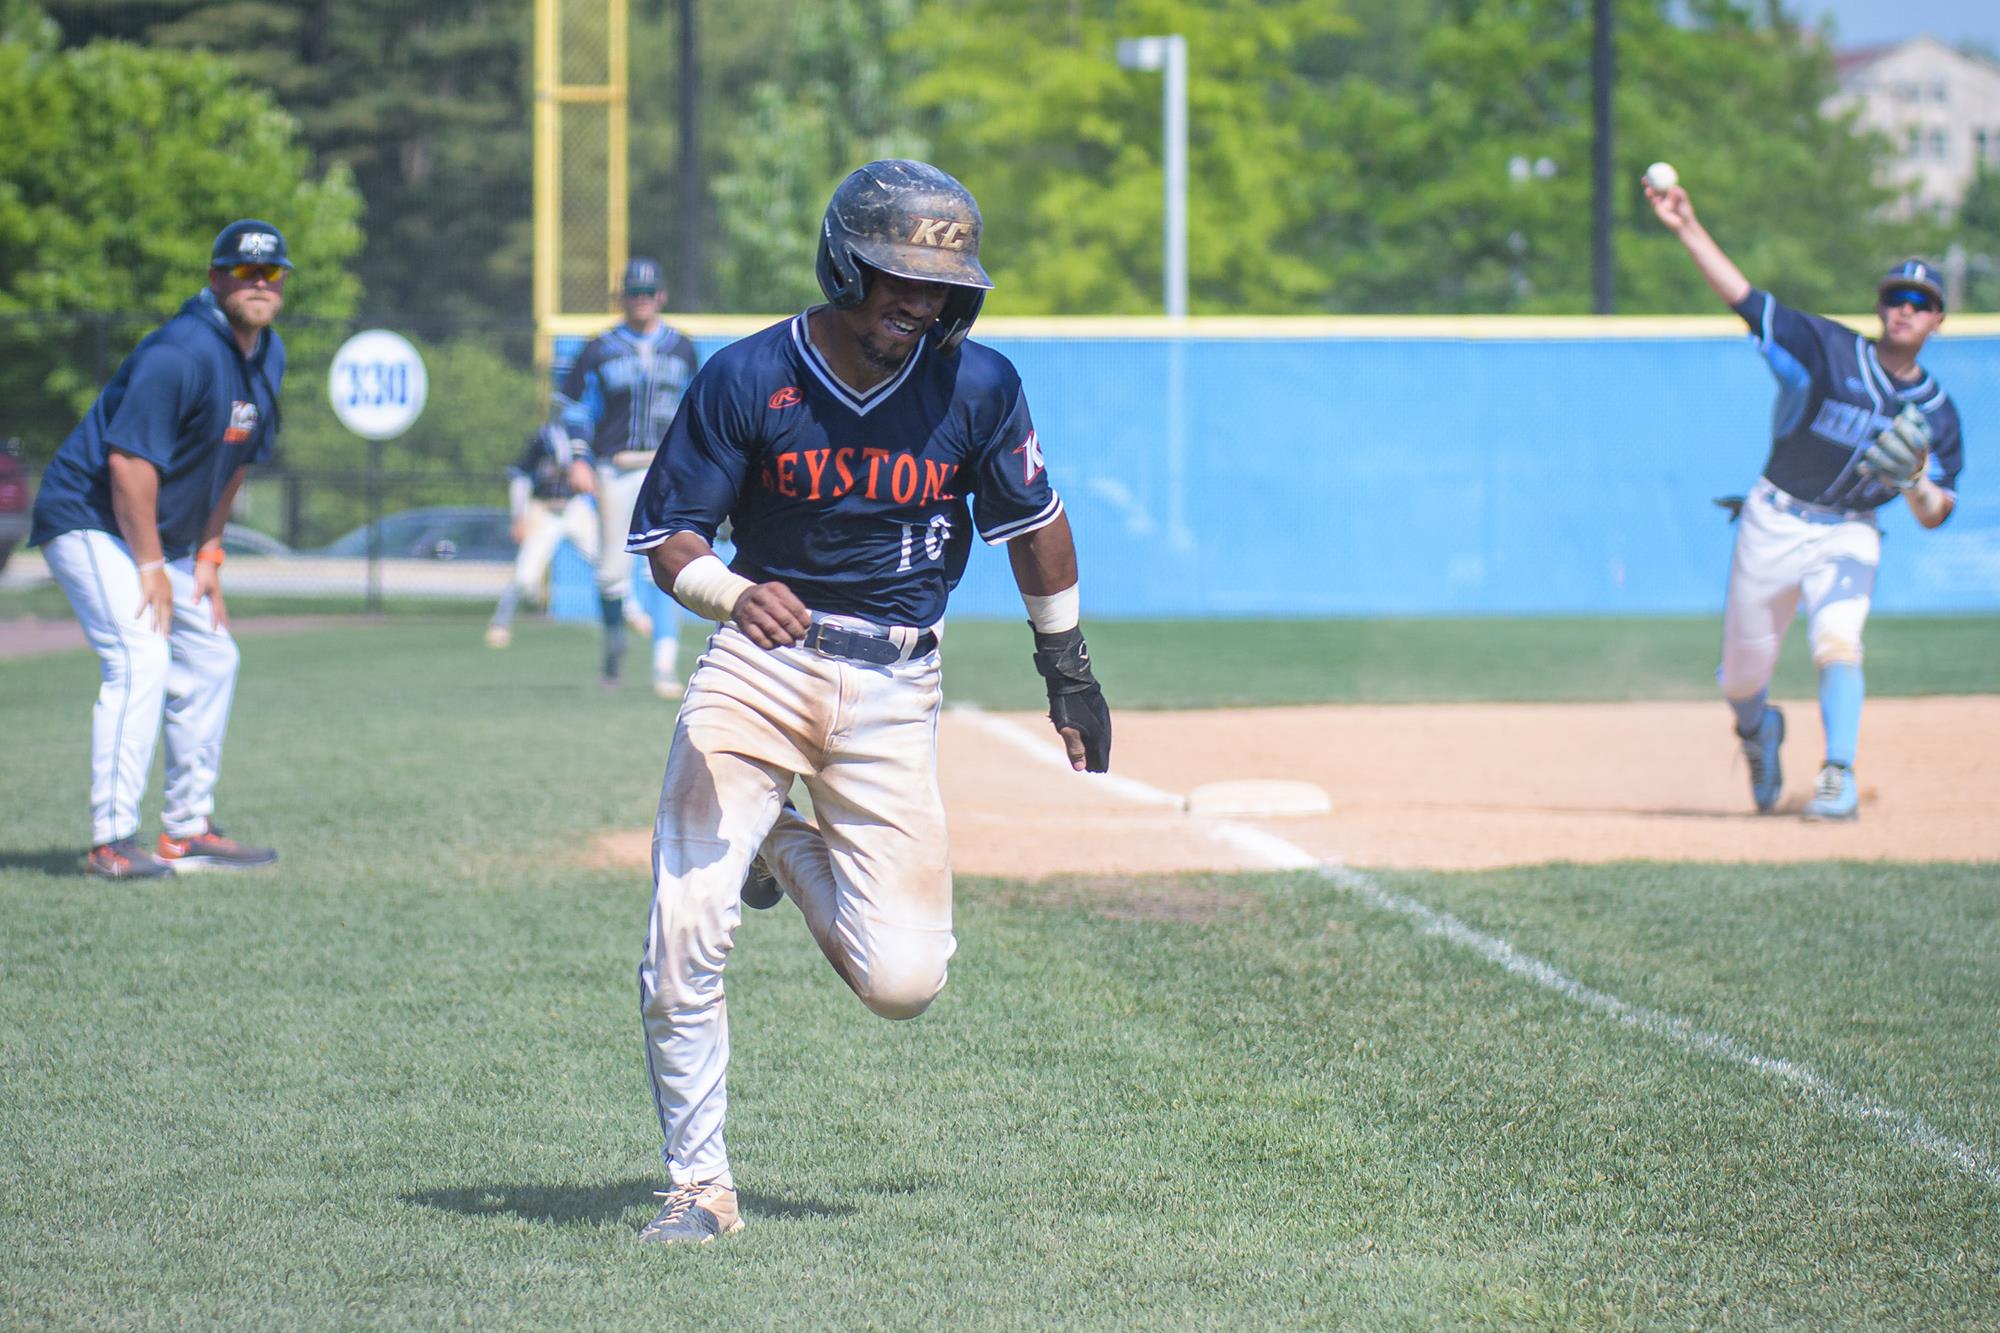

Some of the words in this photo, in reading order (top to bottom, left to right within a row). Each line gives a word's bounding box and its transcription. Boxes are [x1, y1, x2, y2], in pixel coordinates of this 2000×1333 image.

[909, 217, 972, 250] KC
[341, 361, 409, 407] 330
[761, 447, 959, 507] EYSTON
